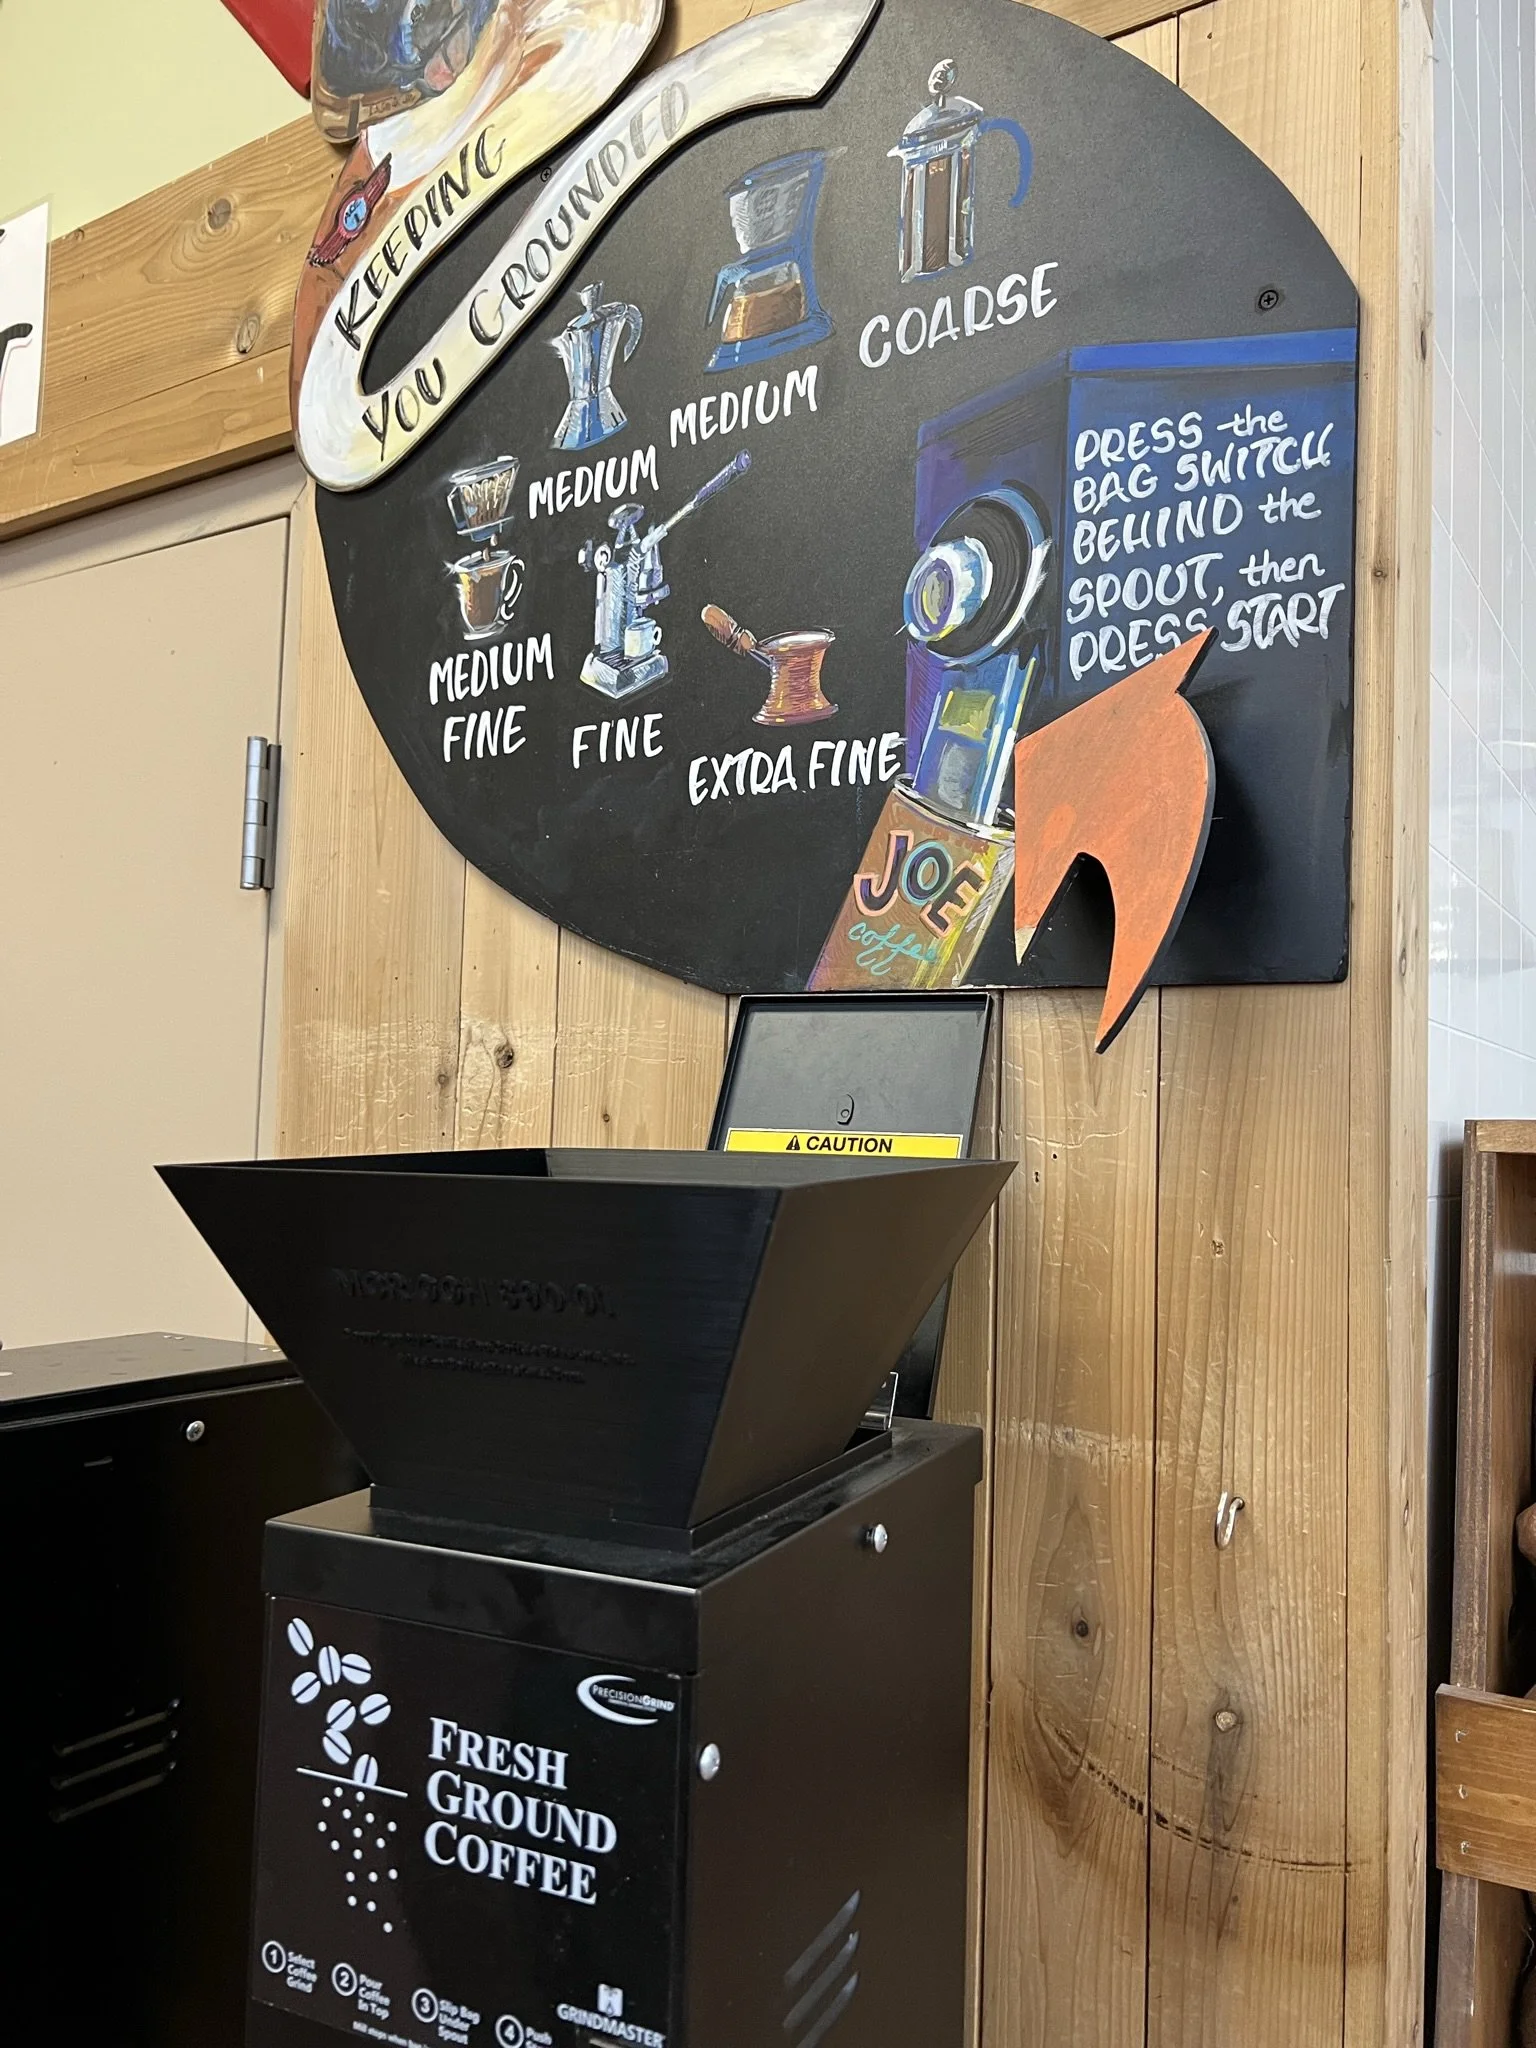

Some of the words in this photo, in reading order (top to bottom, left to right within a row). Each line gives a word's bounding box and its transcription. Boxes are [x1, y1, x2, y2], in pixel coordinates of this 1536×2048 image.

[335, 124, 507, 351] KEEPING
[361, 357, 448, 462] YOU
[468, 82, 687, 346] GROUNDED
[859, 261, 1059, 367] COARSE
[670, 365, 818, 447] MEDIUM
[1074, 411, 1203, 471] PRESS
[1217, 404, 1288, 439] the
[529, 445, 659, 519] MEDIUM
[1073, 463, 1159, 515] BAG
[1175, 423, 1335, 492] SWITCH
[1073, 493, 1243, 565] BEHIND
[1259, 487, 1322, 524] the
[1066, 552, 1223, 624] SPOUT,
[1240, 549, 1326, 588] then
[1221, 583, 1345, 654] START
[429, 633, 554, 705] MEDIUM
[443, 705, 527, 763] FINE
[572, 713, 663, 769] FINE
[687, 745, 796, 806] EXTRA
[808, 731, 903, 790] FINE
[853, 829, 990, 938] JOE
[806, 1136, 893, 1153] CAUTION
[429, 1717, 569, 1790] FRESH
[426, 1770, 617, 1854] GROUND
[424, 1820, 597, 1905] COFFEE
[286, 1964, 318, 1983] Coffee
[286, 1976, 313, 1994] Grind
[287, 1951, 316, 1970] Select
[359, 1974, 383, 1990] Pour
[358, 1987, 391, 2007] Coffee
[370, 2002, 390, 2020] Top
[438, 2012, 470, 2032] Under
[460, 2005, 480, 2025] Bag
[557, 2003, 667, 2048] GRINDMASTER
[438, 2025, 469, 2045] Spout
[525, 2026, 552, 2046] Push
